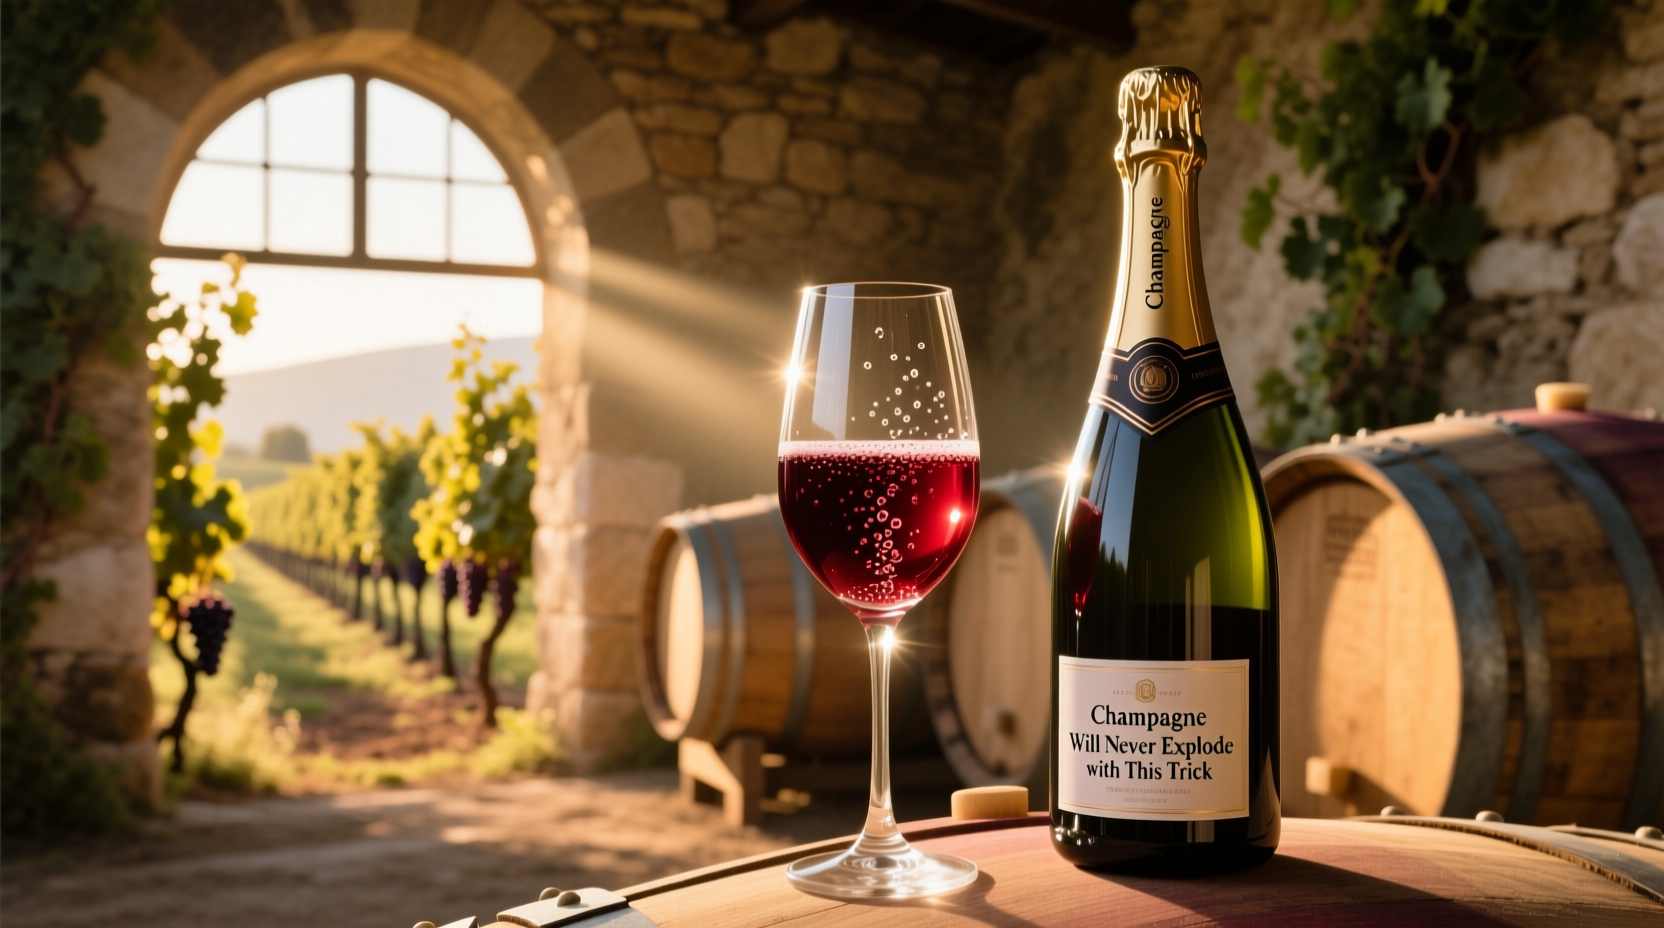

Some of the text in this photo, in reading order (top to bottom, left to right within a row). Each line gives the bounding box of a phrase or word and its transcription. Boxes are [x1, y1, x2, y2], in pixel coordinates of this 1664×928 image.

[1145, 197, 1170, 310] Champagne
[1091, 704, 1207, 732] Champagne
[1069, 732, 1234, 760] Will Never Explode
[1086, 760, 1213, 780] with This Trick
